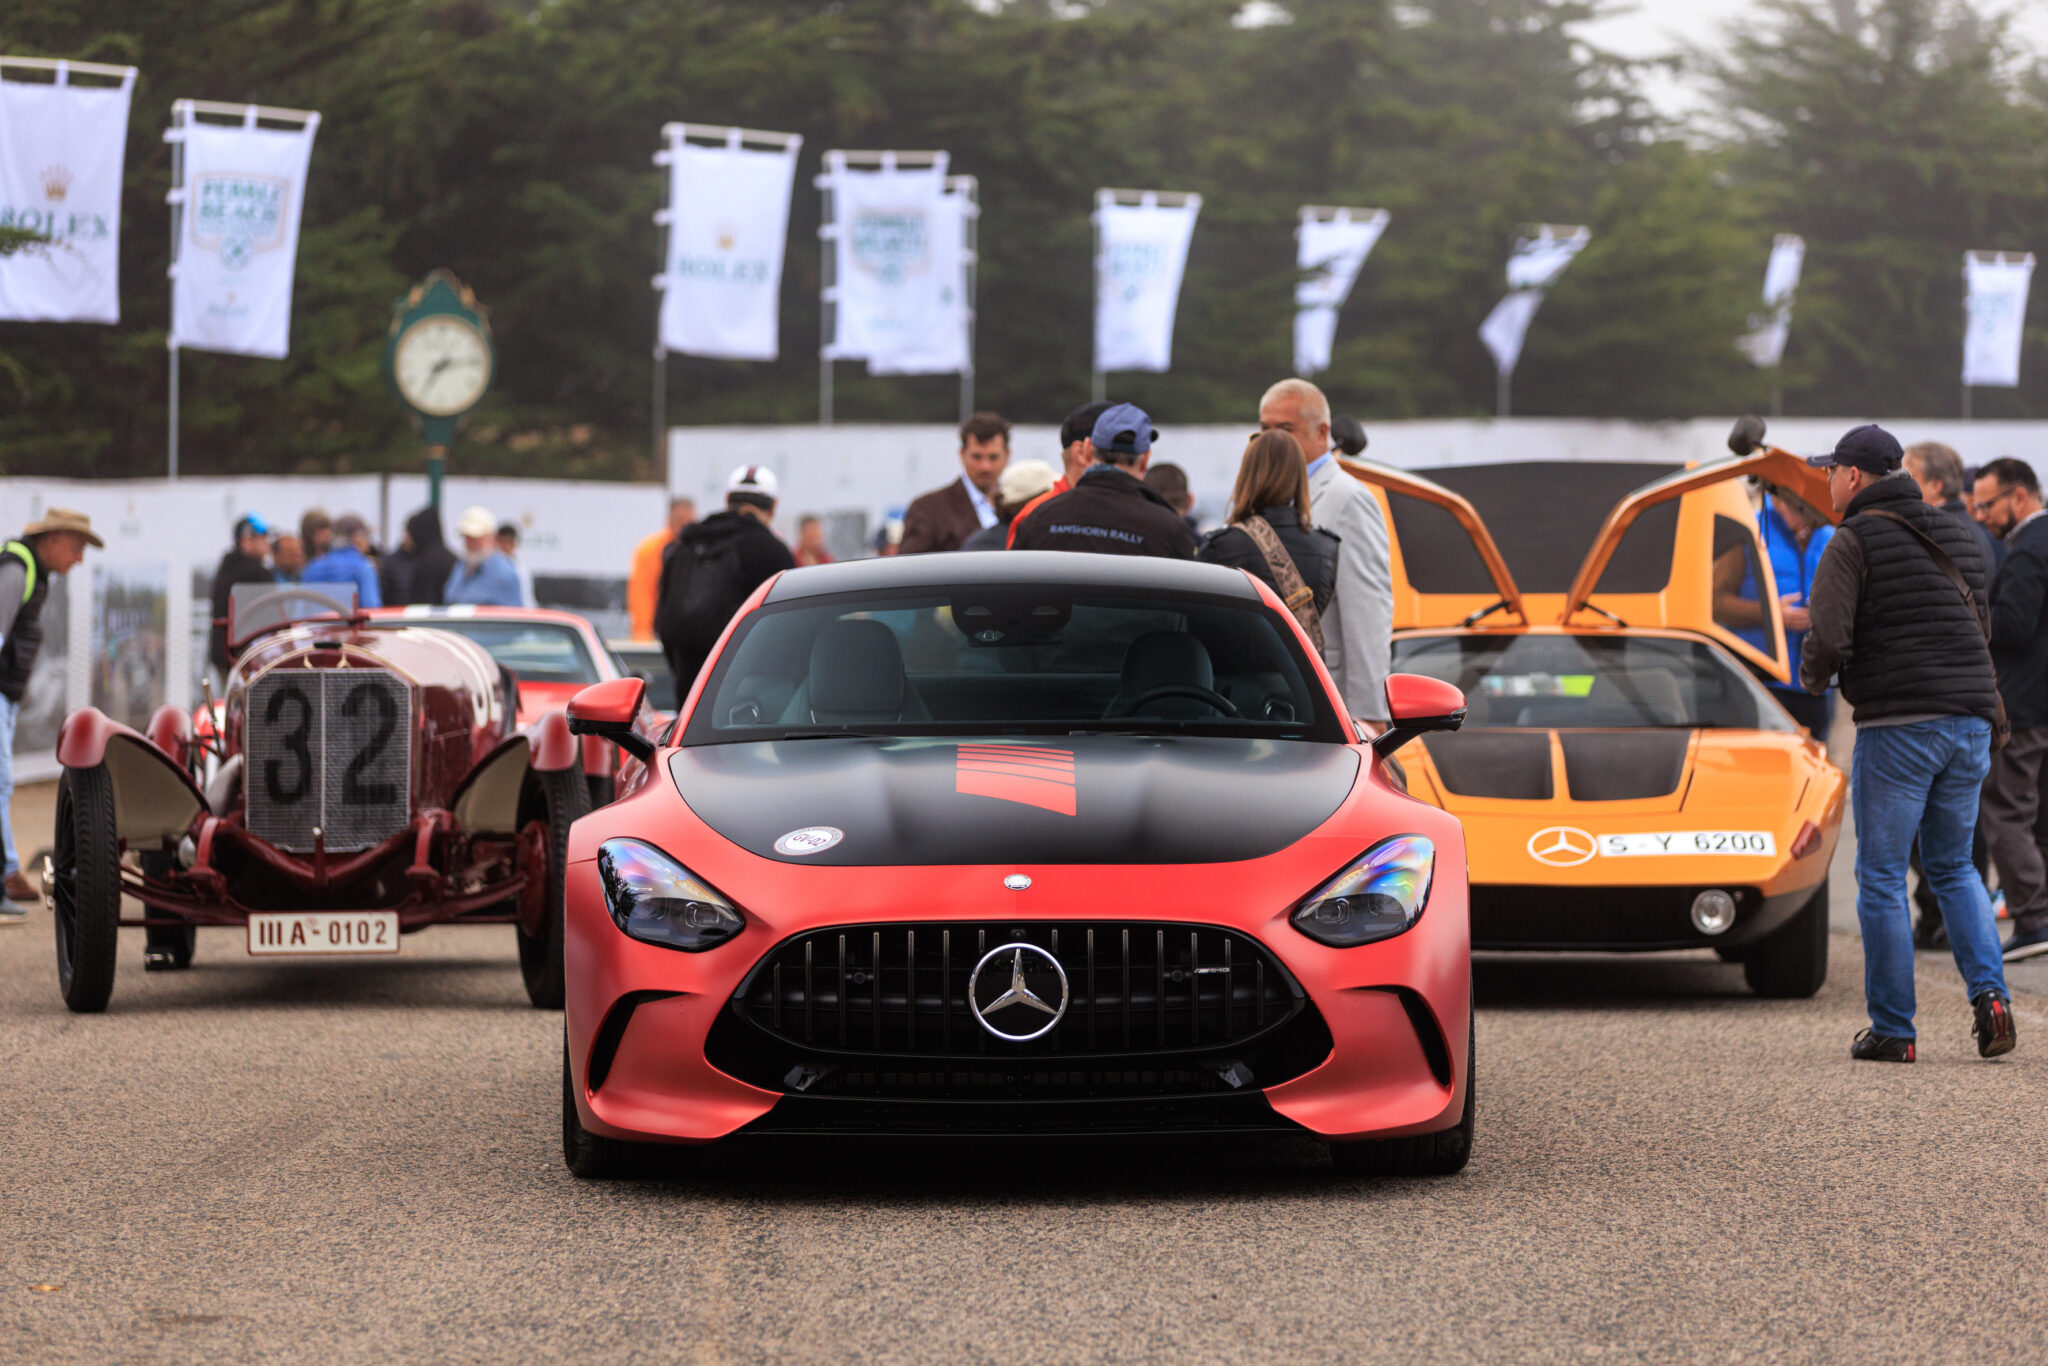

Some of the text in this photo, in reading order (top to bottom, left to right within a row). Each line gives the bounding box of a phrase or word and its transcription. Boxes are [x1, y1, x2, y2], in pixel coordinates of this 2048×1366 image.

[1050, 524, 1144, 544] RAMSHORN RALLY
[265, 682, 398, 805] 32
[1695, 833, 1766, 852] 6200
